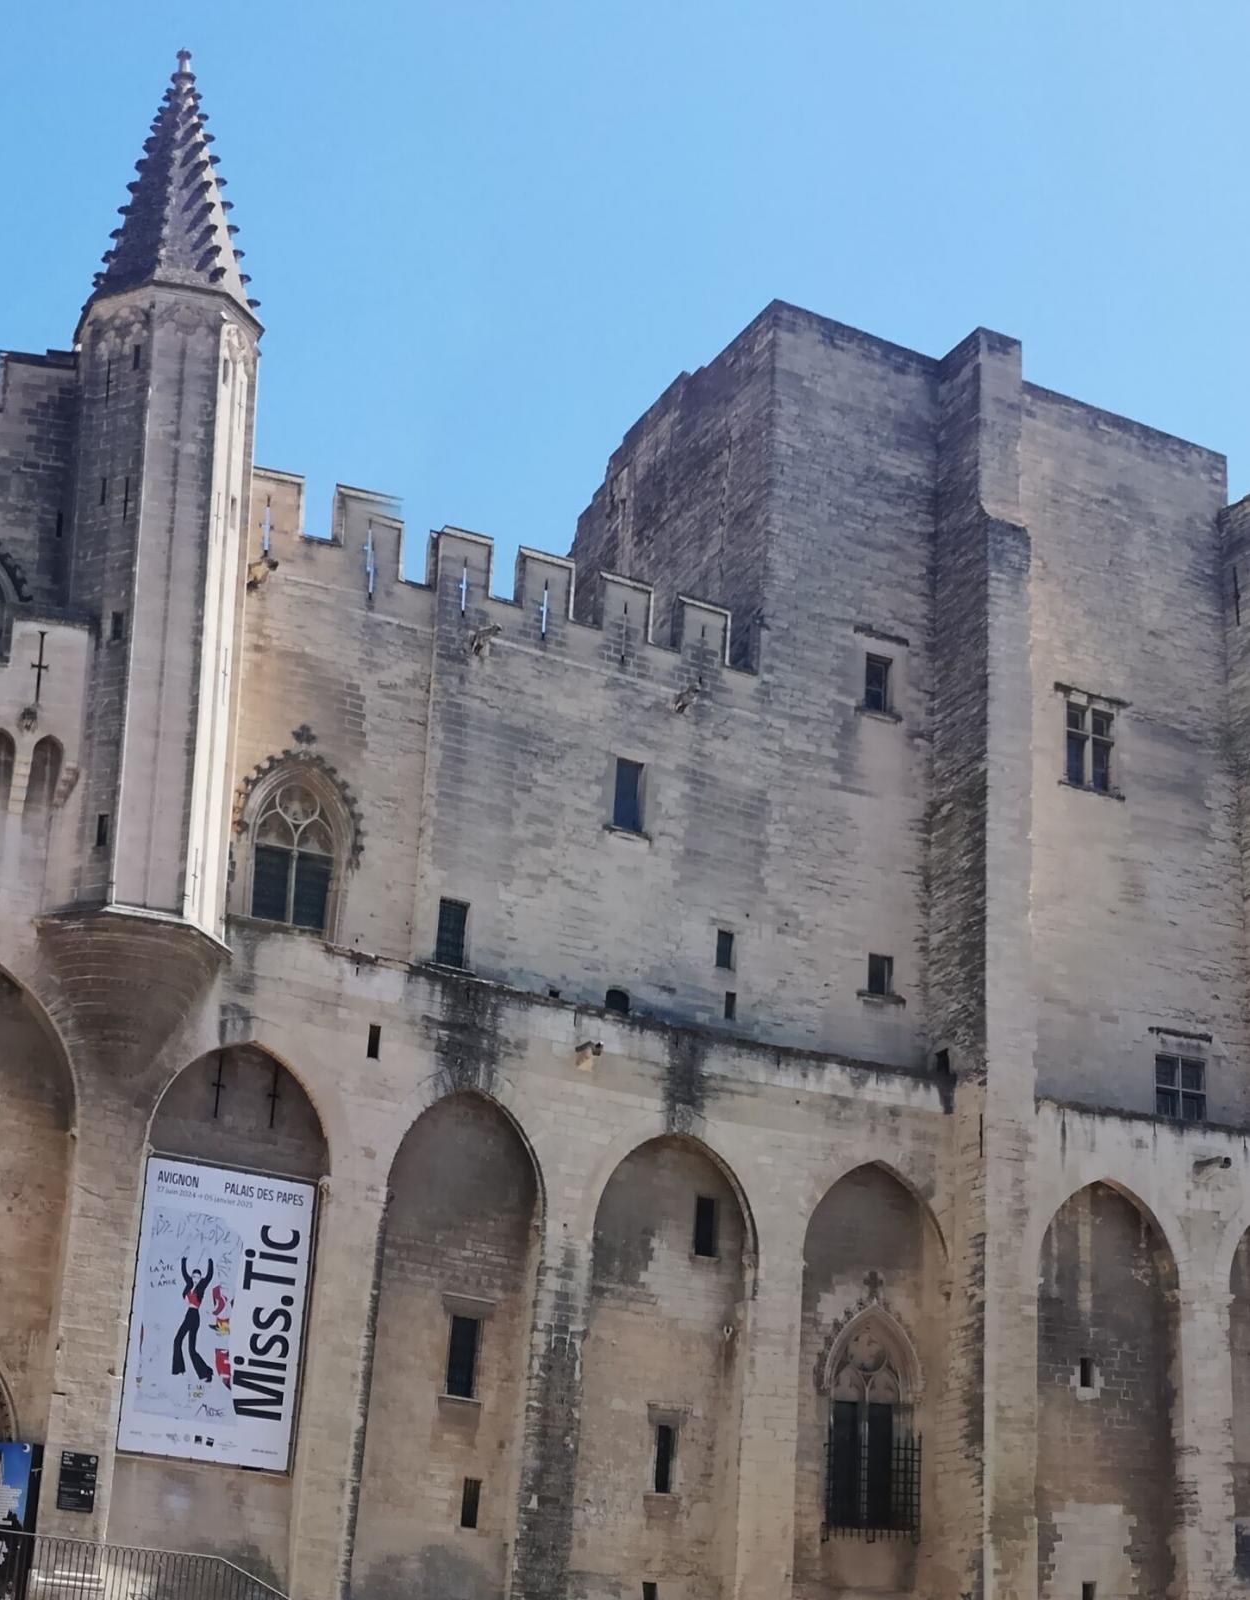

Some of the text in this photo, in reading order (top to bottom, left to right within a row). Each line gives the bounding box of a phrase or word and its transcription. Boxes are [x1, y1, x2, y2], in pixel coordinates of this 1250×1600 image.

[157, 1170, 200, 1188] AVIGNON
[164, 1187, 178, 1196] juin
[179, 1189, 197, 1198] 2024
[213, 1195, 236, 1206] janvier
[236, 1199, 253, 1208] 2025
[224, 1182, 304, 1206] PALAIS DES PAPES
